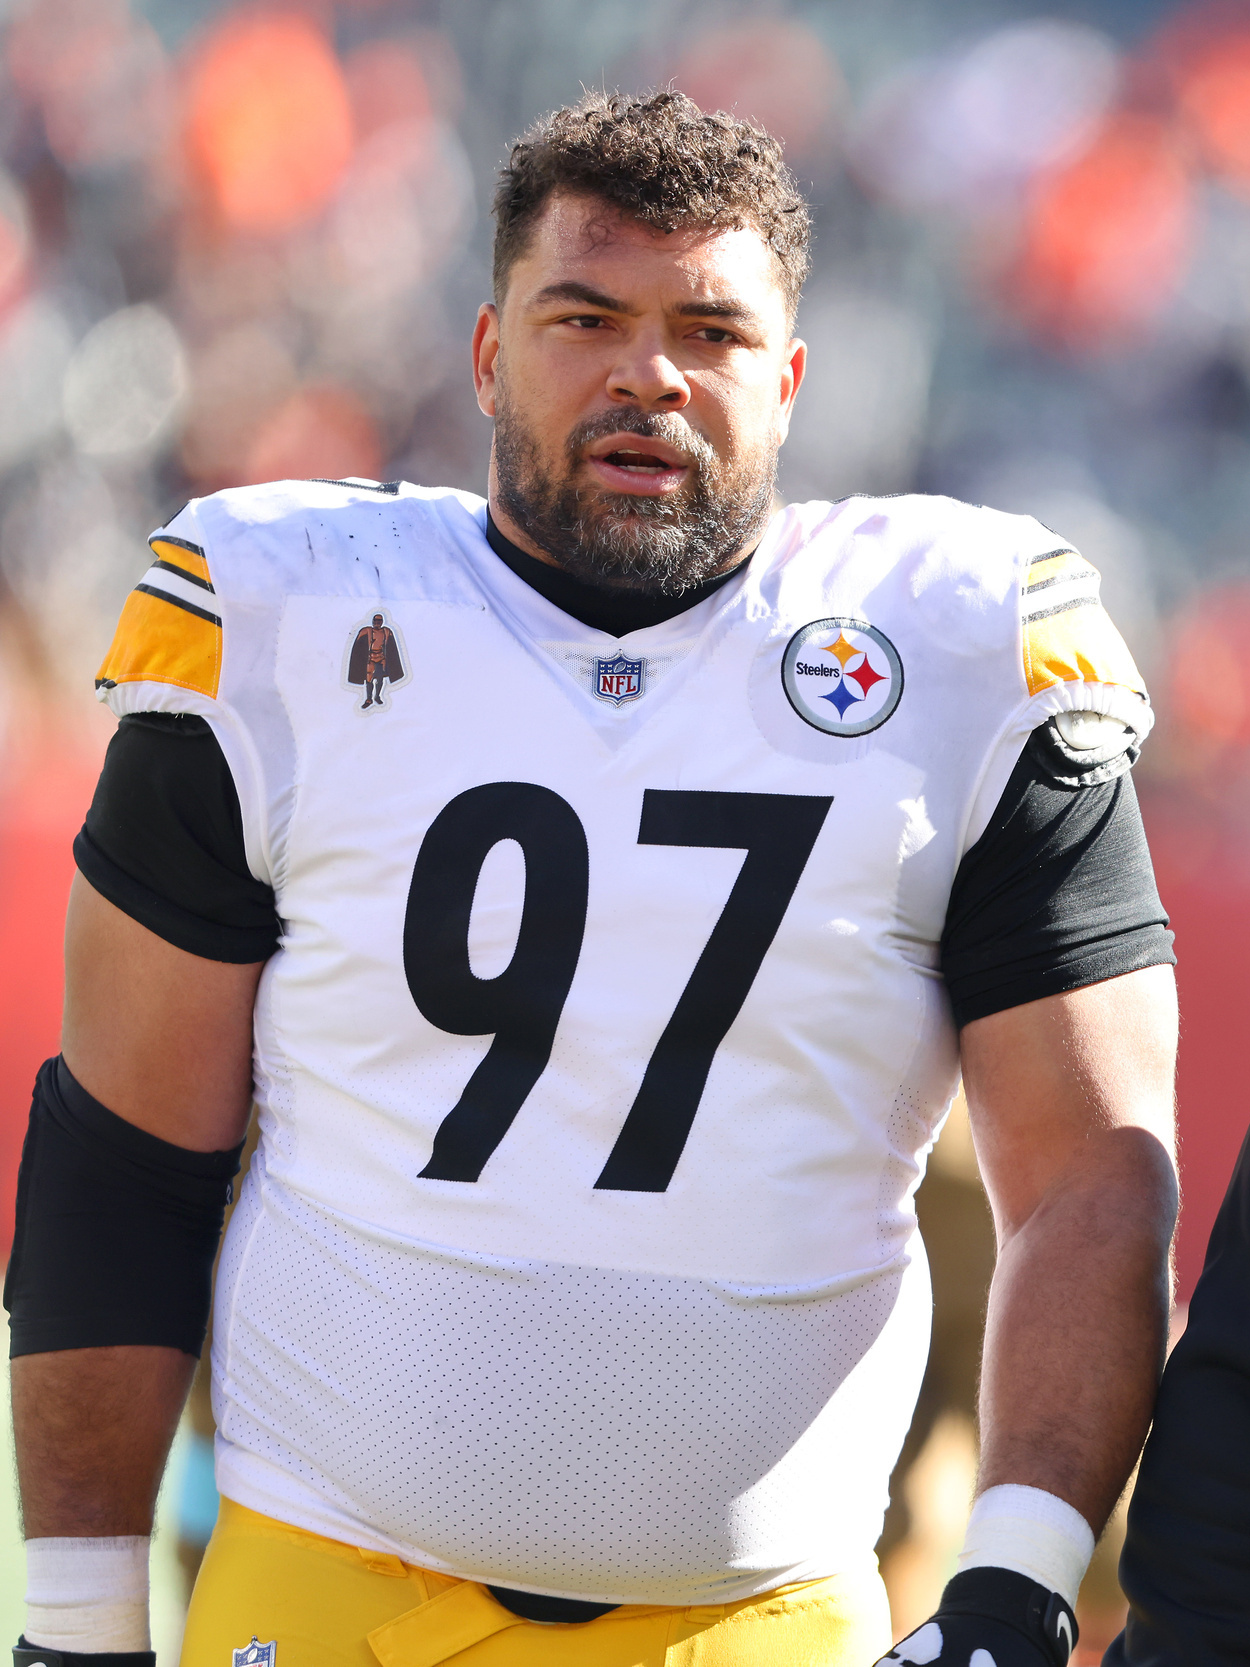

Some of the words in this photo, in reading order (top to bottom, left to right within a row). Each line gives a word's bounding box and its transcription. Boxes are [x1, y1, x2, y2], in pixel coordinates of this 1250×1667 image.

[796, 662, 840, 678] Steelers
[601, 675, 637, 695] NFL
[403, 782, 834, 1192] 97
